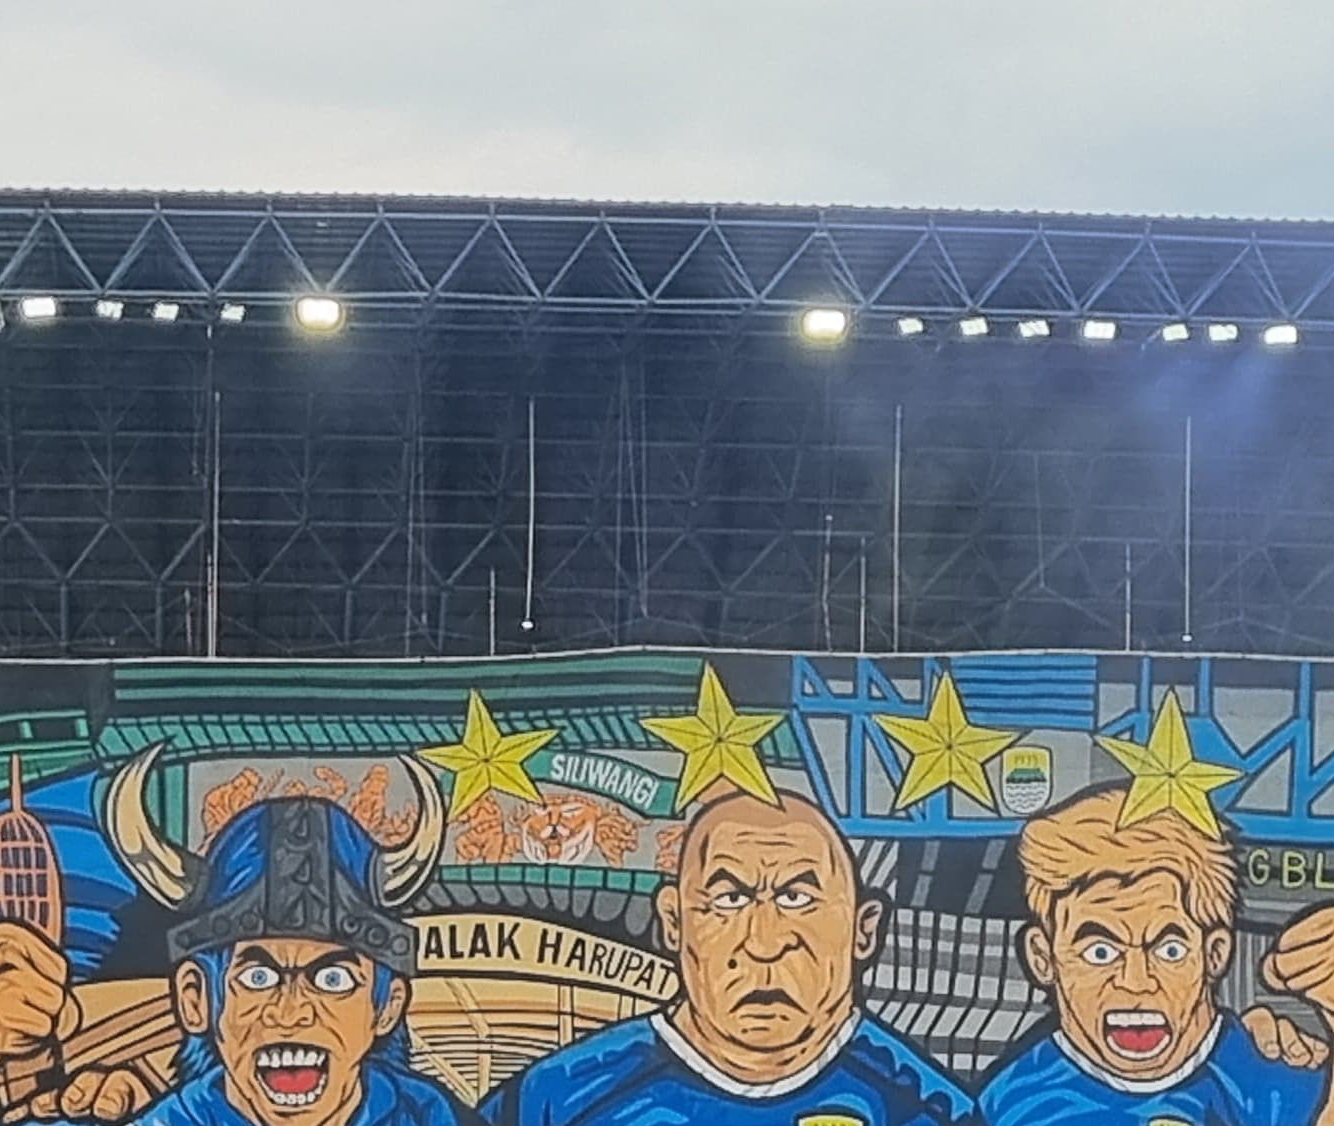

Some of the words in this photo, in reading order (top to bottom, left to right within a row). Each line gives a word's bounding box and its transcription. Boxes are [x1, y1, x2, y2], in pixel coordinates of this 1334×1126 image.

[549, 753, 660, 811] SILIWANGI
[423, 921, 522, 961] ALAK
[536, 928, 674, 996] HARUPAT
